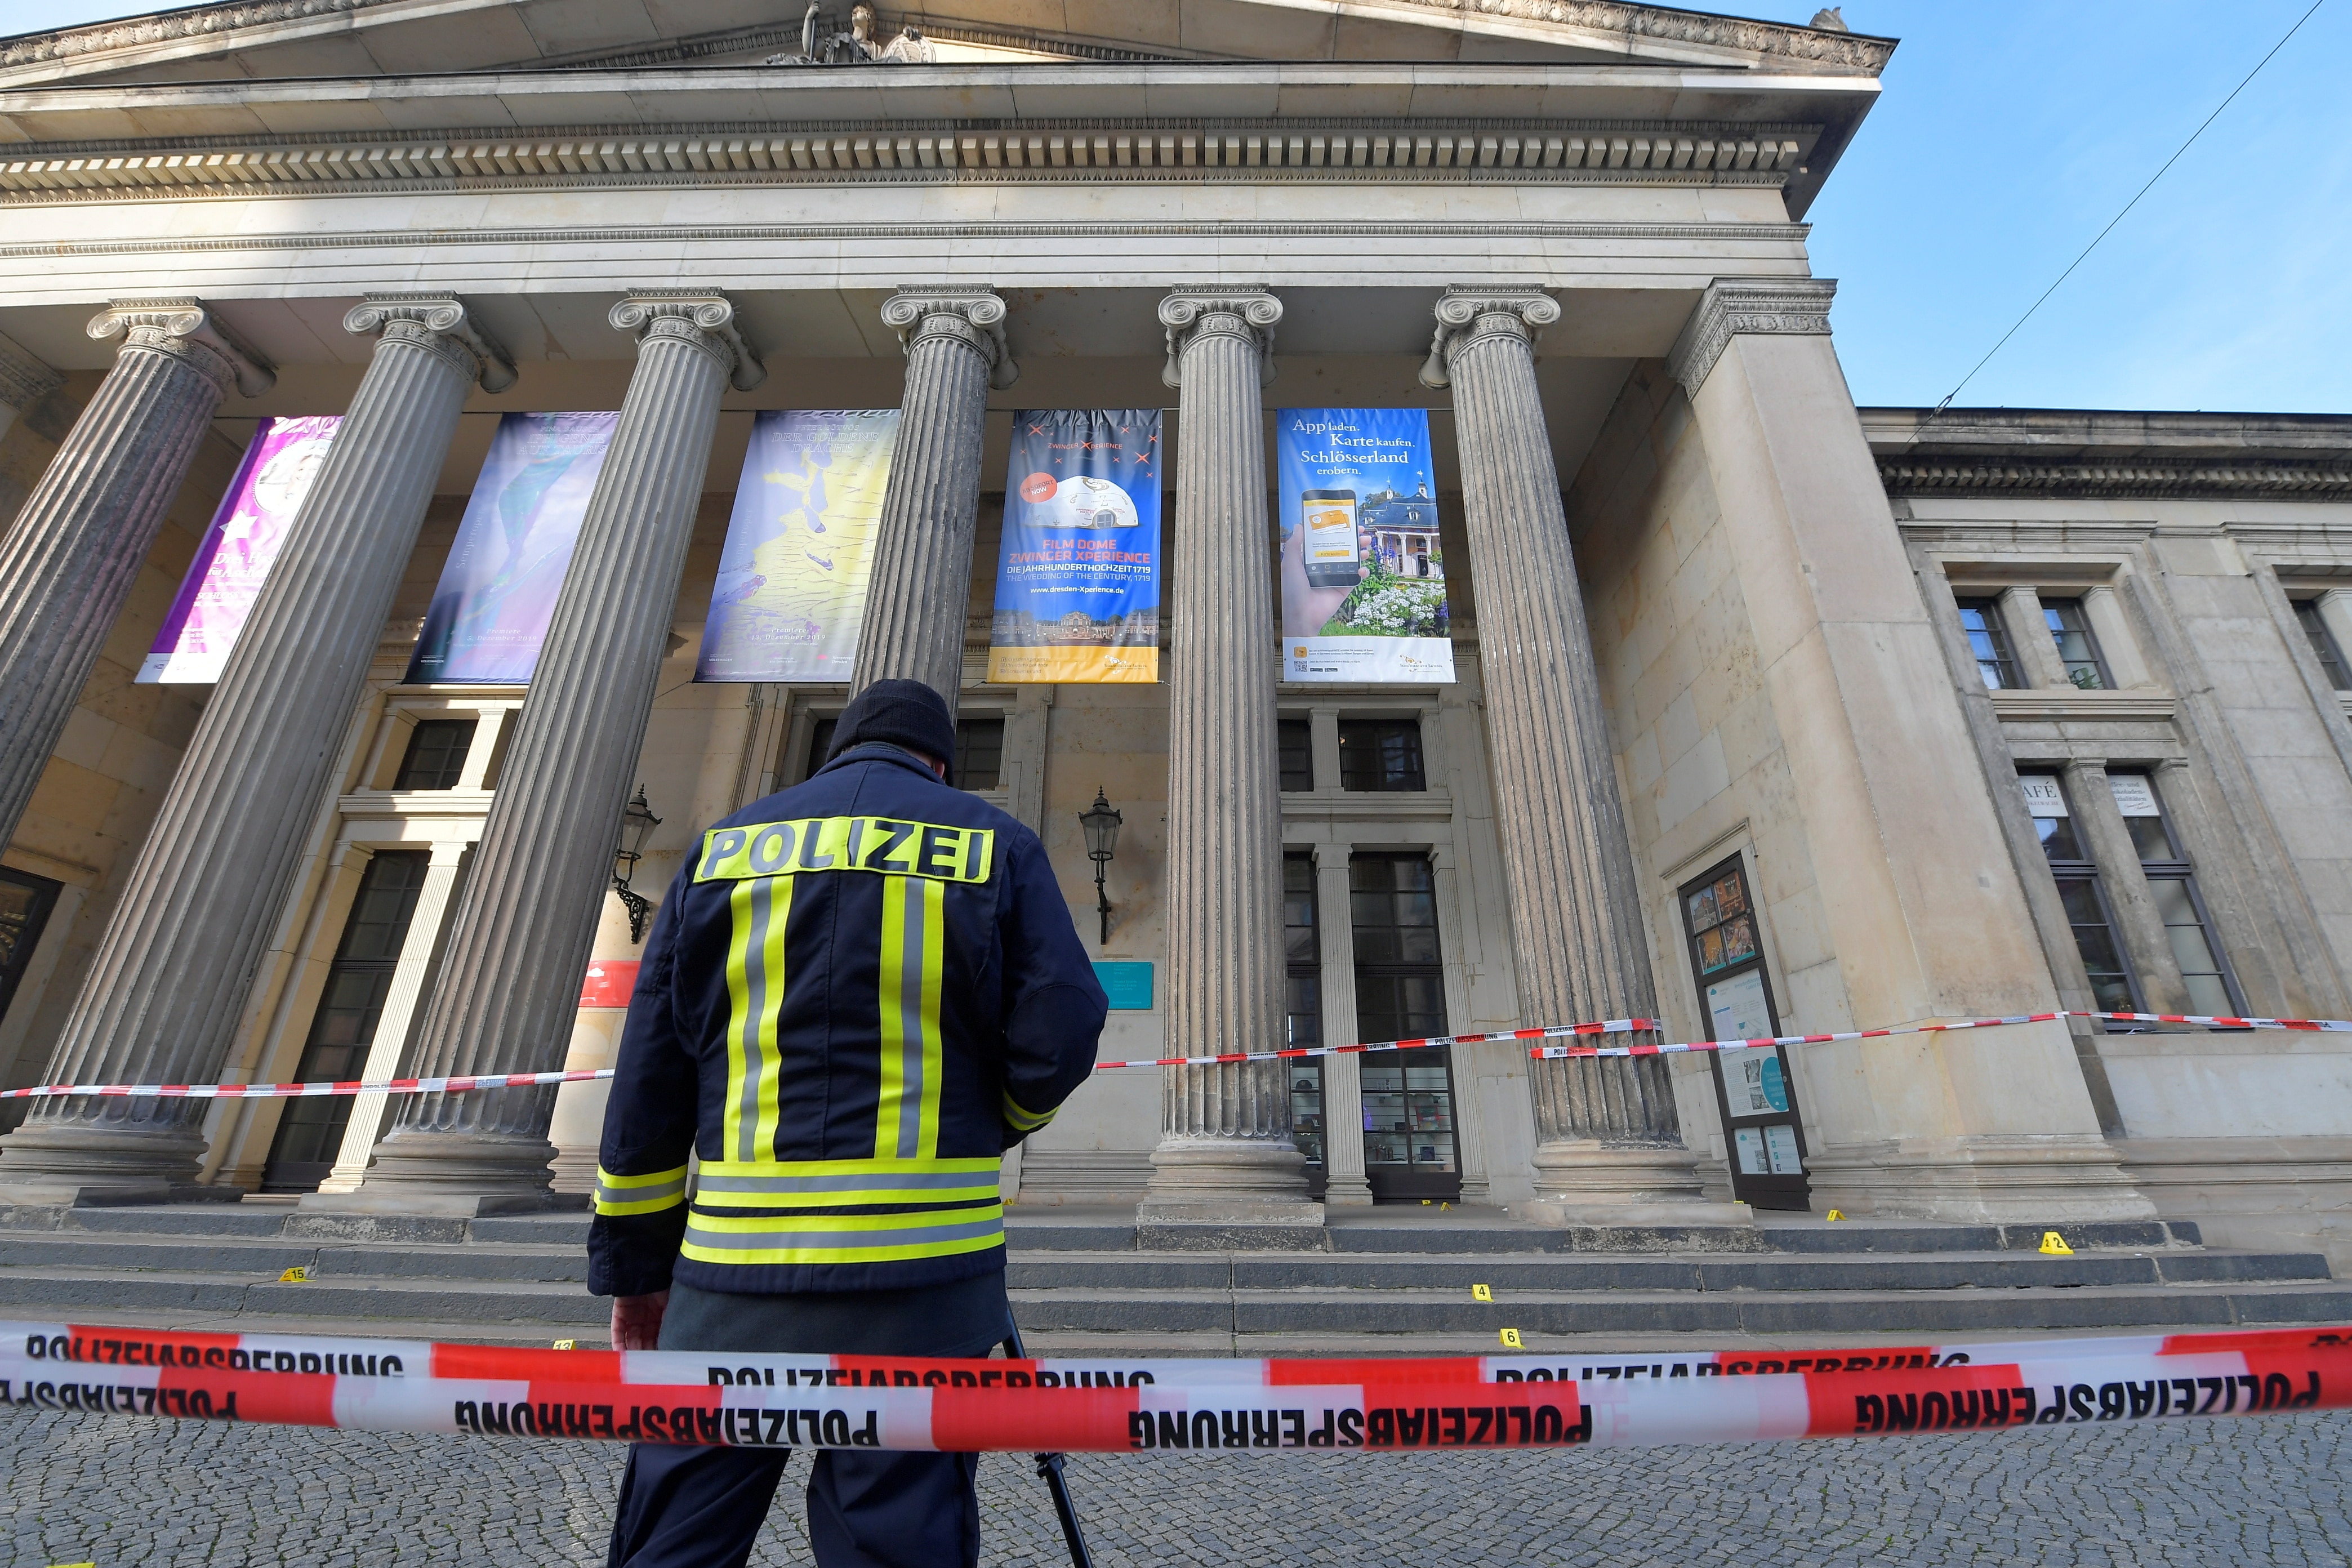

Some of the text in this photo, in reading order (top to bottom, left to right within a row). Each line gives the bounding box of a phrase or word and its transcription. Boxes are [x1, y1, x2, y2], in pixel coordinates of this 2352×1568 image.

[1293, 419, 1360, 435] App laden.
[527, 434, 607, 443] IPHIGENIE
[772, 432, 880, 442] DER GOLDENE
[1330, 433, 1415, 447] Karte kaufen.
[516, 445, 608, 455] AUF TAURIS
[791, 443, 854, 453] DRACHE
[1300, 450, 1409, 464] Schlösserland
[1317, 466, 1361, 475] erobern.
[1031, 480, 1054, 490] SOFORT
[1031, 487, 1048, 496] NOW
[1043, 539, 1117, 550] FILM DOME
[1009, 550, 1150, 563] ZWINGER XPERIENCE
[1022, 563, 1132, 574] JAHRHUNDERTHOCHZEIT
[1094, 573, 1133, 582] CENTURY,
[1030, 586, 1124, 594] www.dresden-Xperience.de
[2023, 781, 2057, 798] AFÉ
[701, 819, 984, 879] POLIZEI
[2053, 1237, 2064, 1248] 2
[292, 1269, 304, 1279] 15
[1479, 1286, 1486, 1296] 4
[1507, 1331, 1515, 1342] 6
[454, 1400, 881, 1449] POLIZEIABSPERRUNG
[1129, 1405, 1593, 1449] POLIZEIABSPERRUNG
